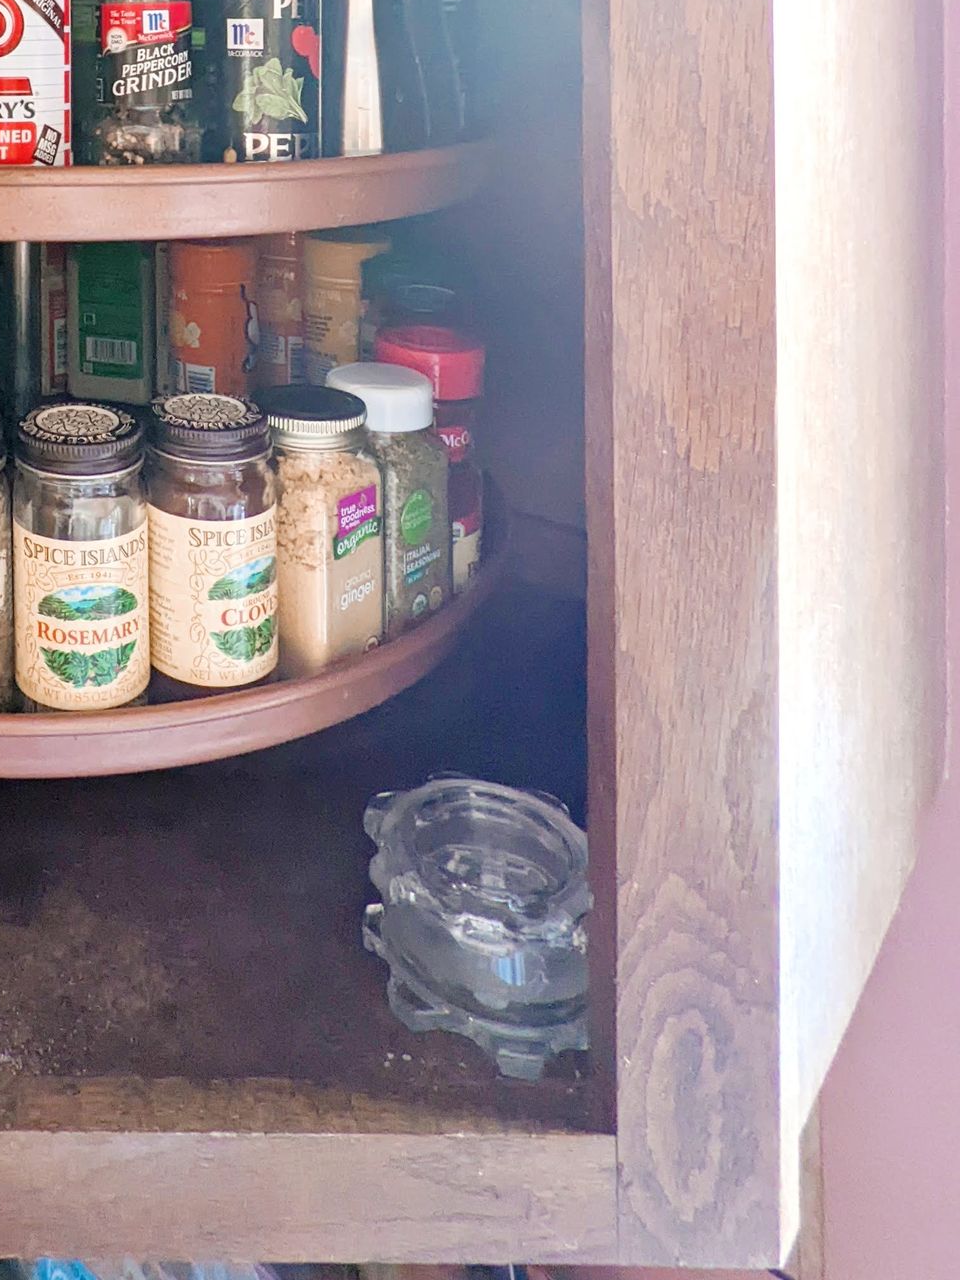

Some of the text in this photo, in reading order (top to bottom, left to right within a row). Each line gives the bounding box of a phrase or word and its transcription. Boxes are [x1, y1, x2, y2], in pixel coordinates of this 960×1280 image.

[138, 31, 174, 41] McCormick
[137, 43, 175, 62] BLACK
[122, 50, 189, 78] PEPPERCORN
[112, 61, 192, 96] GRINDER
[39, 138, 57, 154] MSG
[45, 129, 57, 142] NO
[35, 150, 54, 163] ADDED
[340, 504, 376, 527] goodness
[341, 504, 357, 517] true
[189, 527, 247, 547] SPICE
[337, 519, 378, 555] organic
[24, 536, 75, 566] SPICE
[80, 531, 146, 567] ISLANDS
[340, 579, 375, 610] ginger
[37, 619, 139, 645] ROSEMARY
